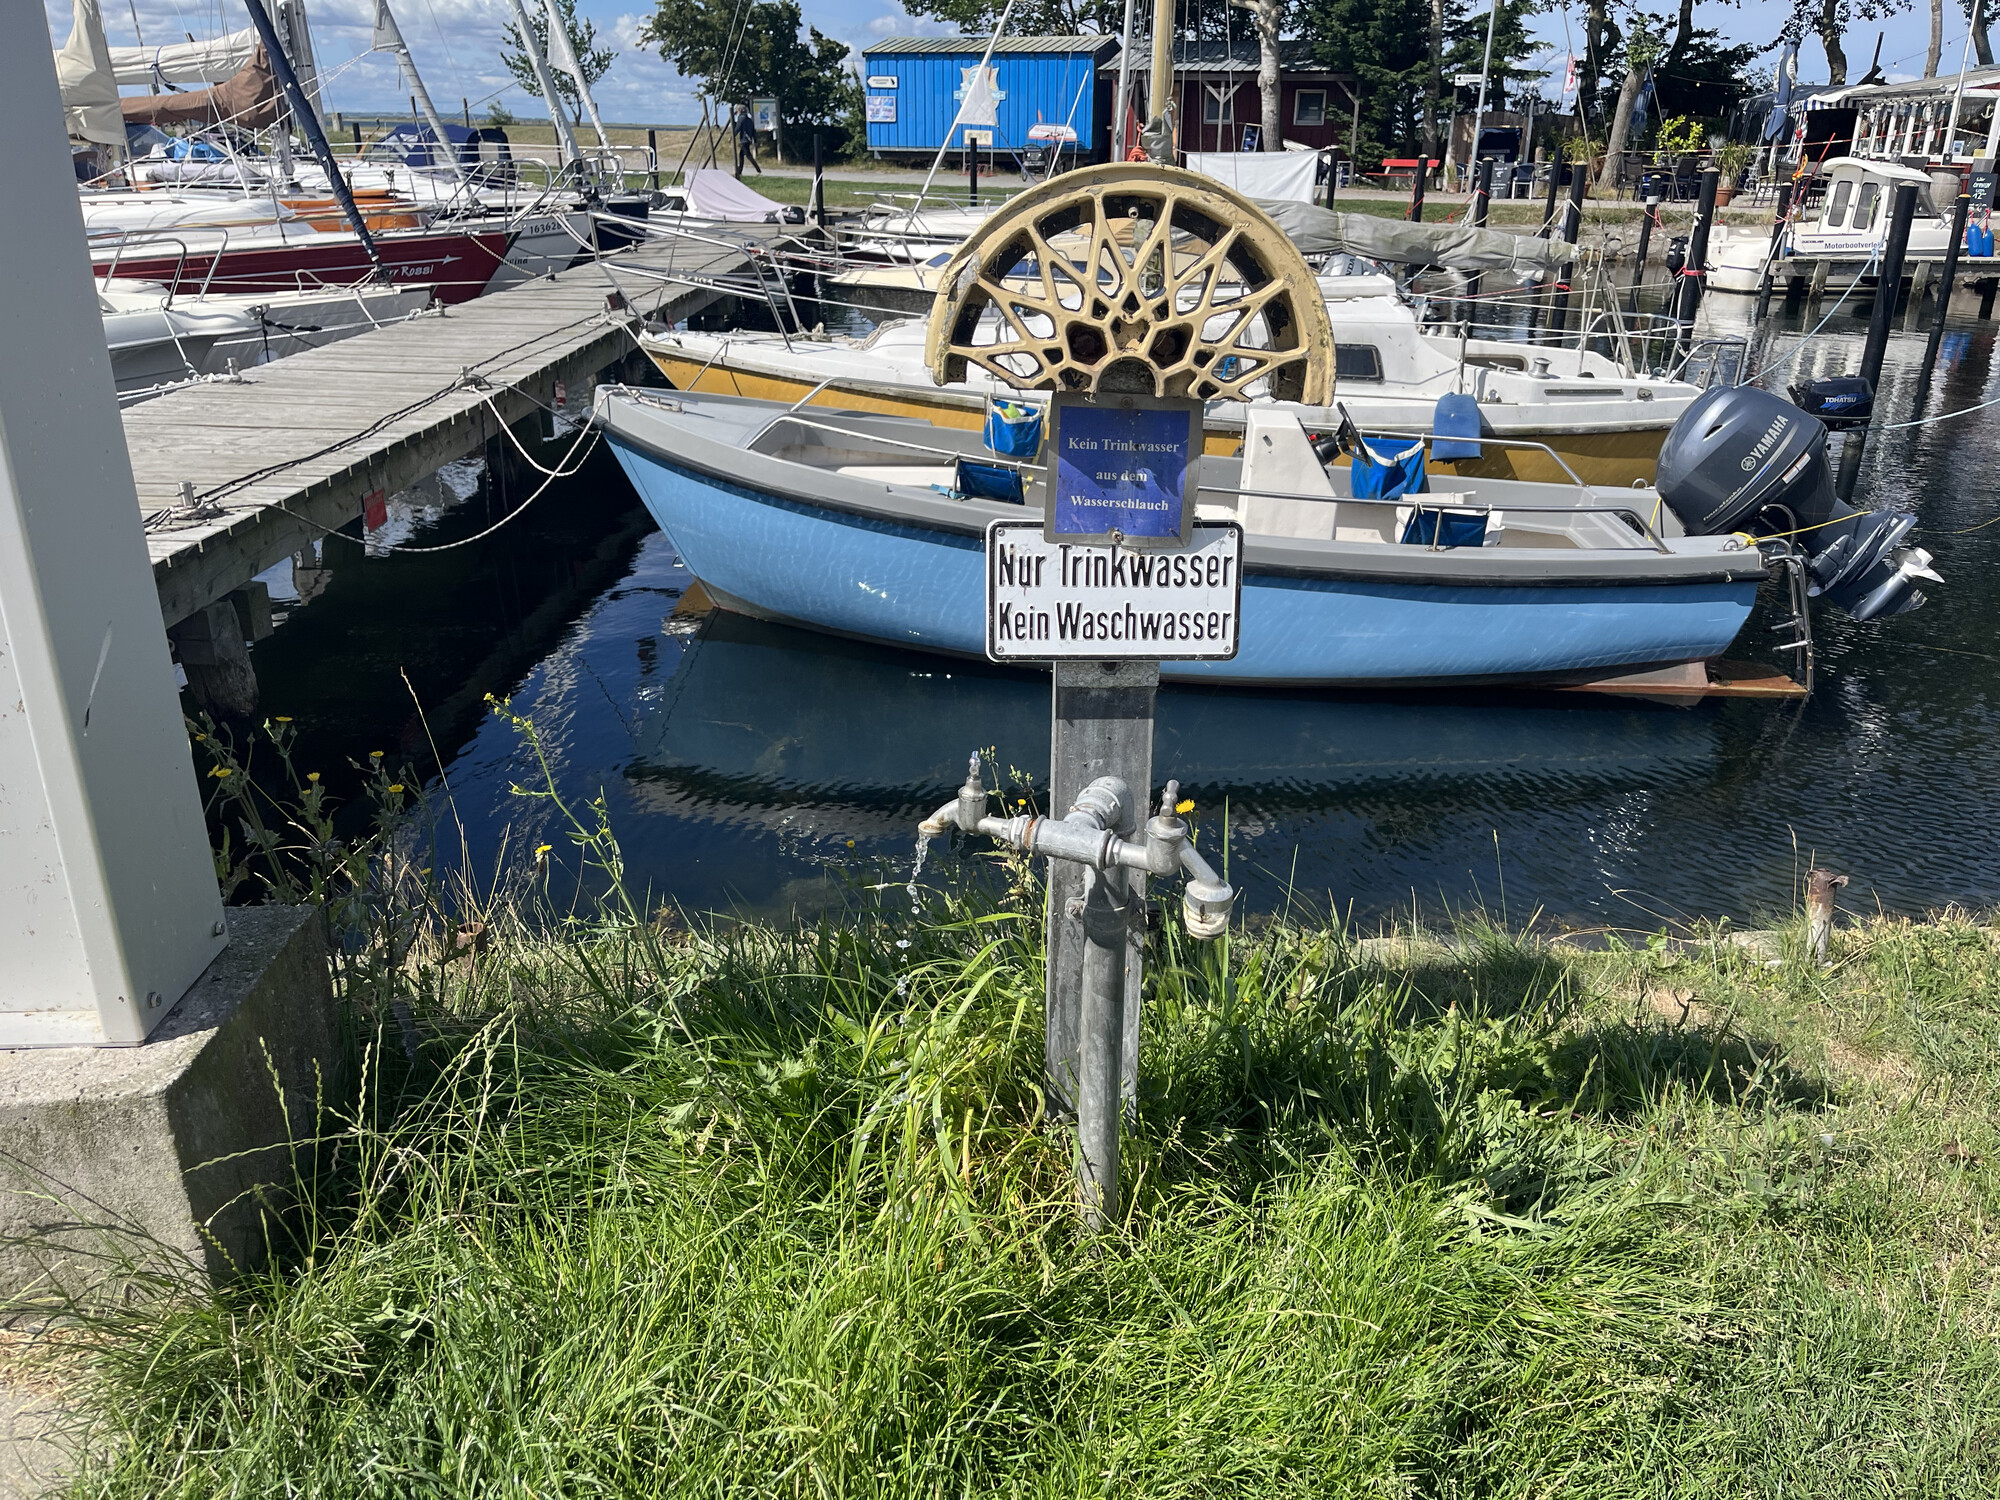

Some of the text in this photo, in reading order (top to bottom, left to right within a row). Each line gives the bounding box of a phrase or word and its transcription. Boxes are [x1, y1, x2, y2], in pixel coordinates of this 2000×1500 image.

[1068, 437, 1180, 453] Kein Trinkwasser
[1750, 414, 1789, 460] YAMAHA
[1096, 468, 1148, 482] aus dem
[1071, 495, 1169, 511] Wasserschlauch
[998, 544, 1233, 588] Nur Trinkwasser
[998, 602, 1233, 641] Kein Waschwasser
